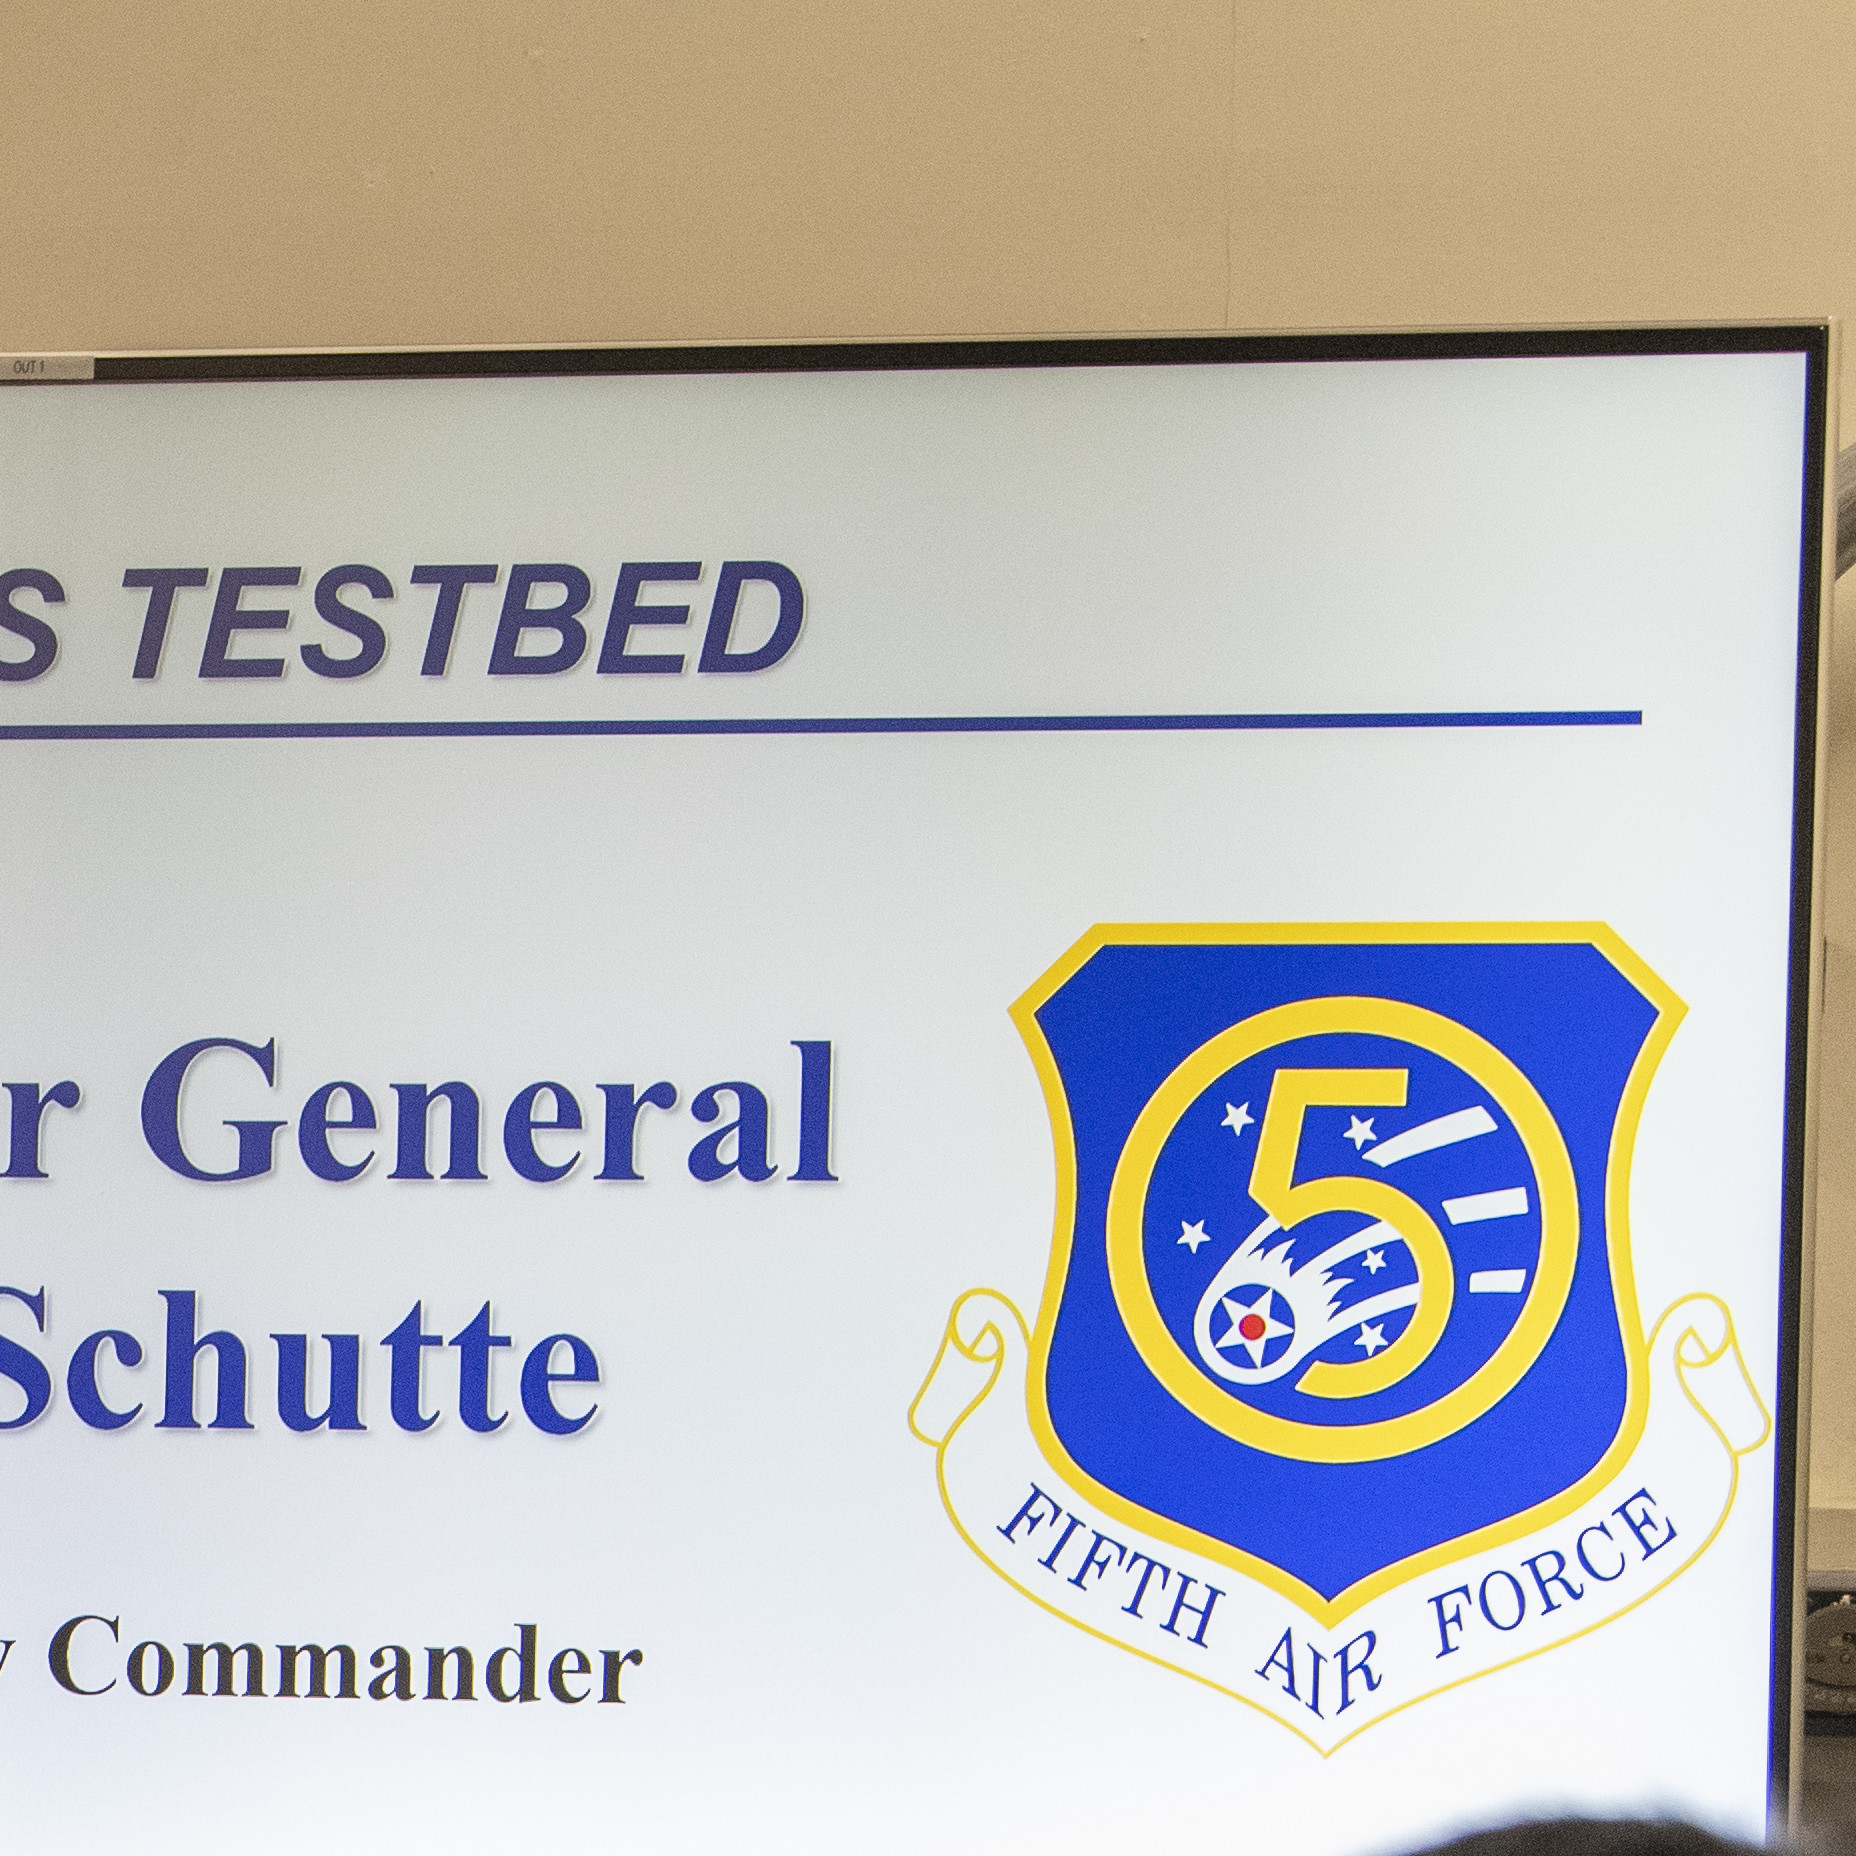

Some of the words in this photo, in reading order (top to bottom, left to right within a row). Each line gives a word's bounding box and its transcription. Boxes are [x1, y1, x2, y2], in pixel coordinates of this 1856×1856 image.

[122, 560, 806, 681] TESTBED
[140, 1037, 839, 1184] General
[1246, 1066, 1455, 1400] 5
[47, 1613, 644, 1705] Commander
[995, 1481, 1227, 1648] FIFTH
[1253, 1626, 1383, 1721] AIR
[1427, 1487, 1679, 1659] FORCE
